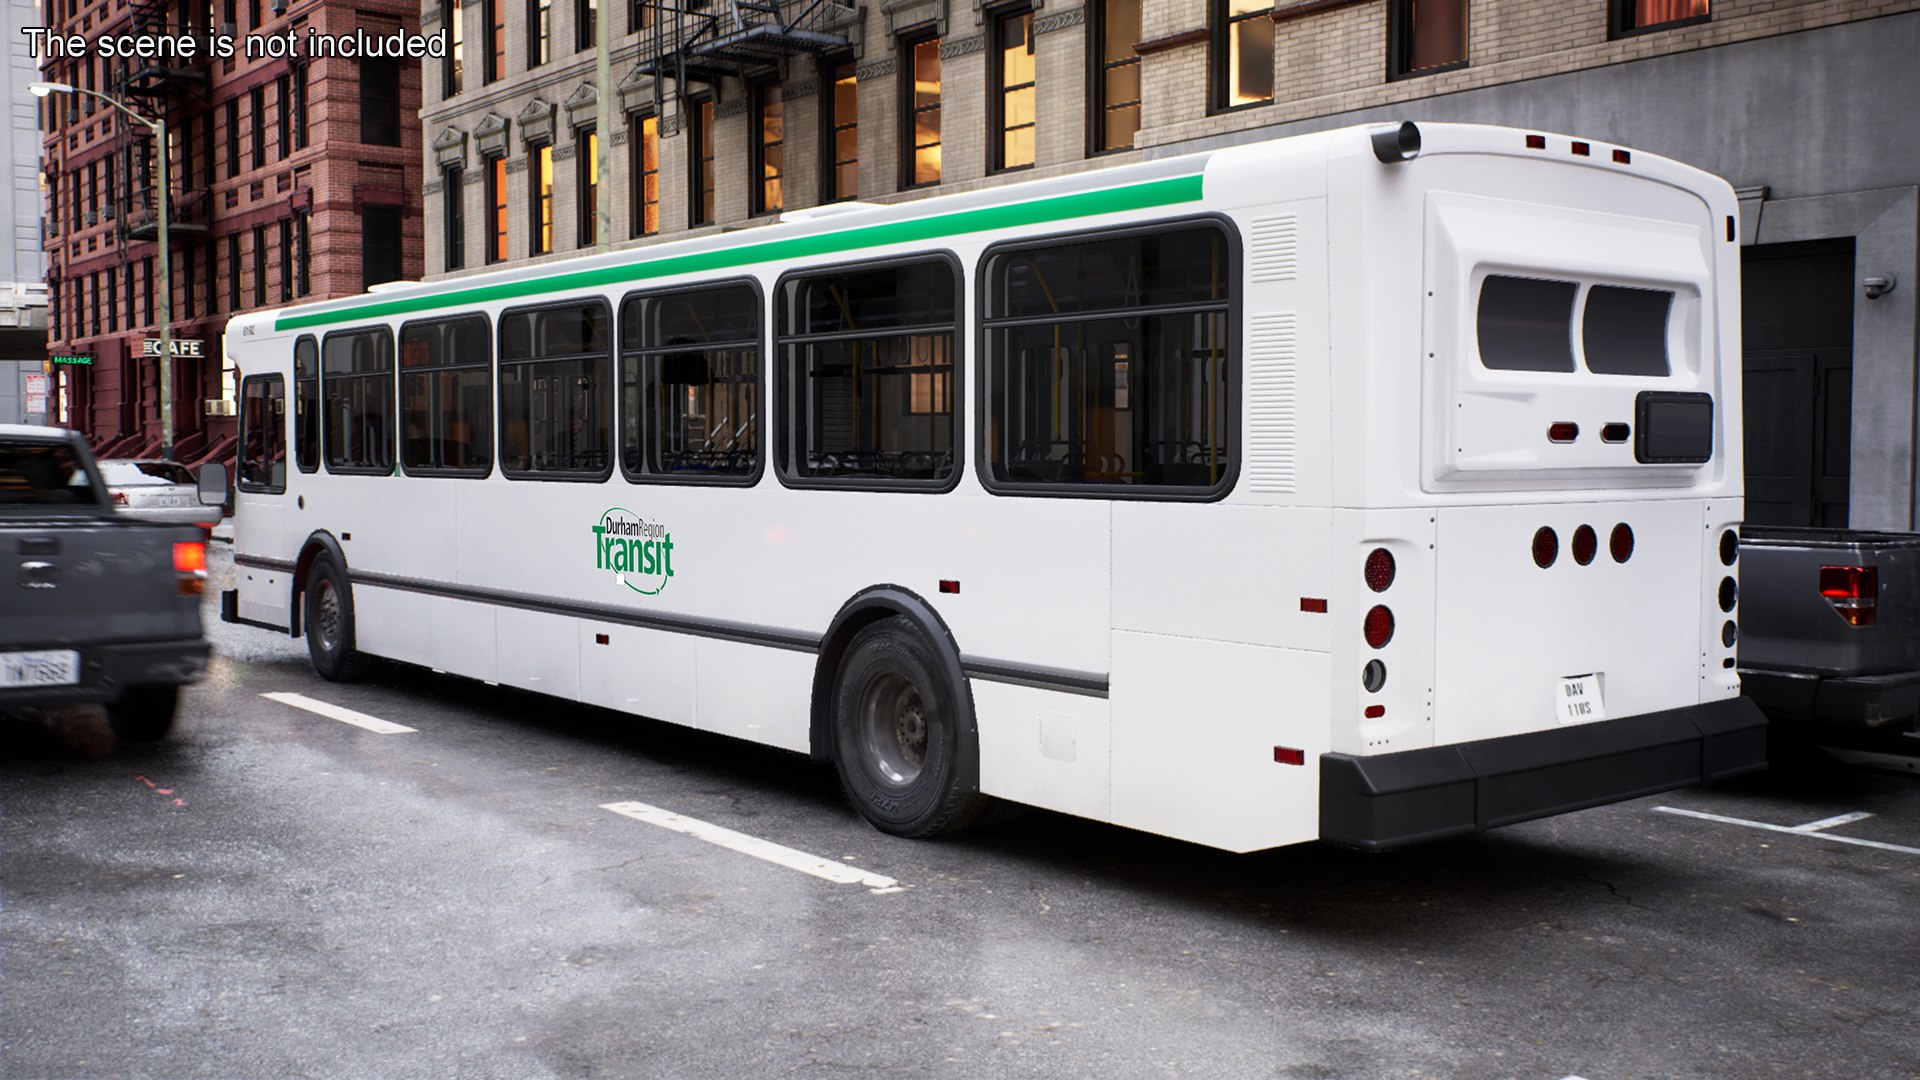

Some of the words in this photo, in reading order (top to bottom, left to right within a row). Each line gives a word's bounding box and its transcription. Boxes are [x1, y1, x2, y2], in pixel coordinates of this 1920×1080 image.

[54, 356, 92, 365] MASSAGE
[592, 525, 674, 577] Transit
[1564, 683, 1583, 697] DAV
